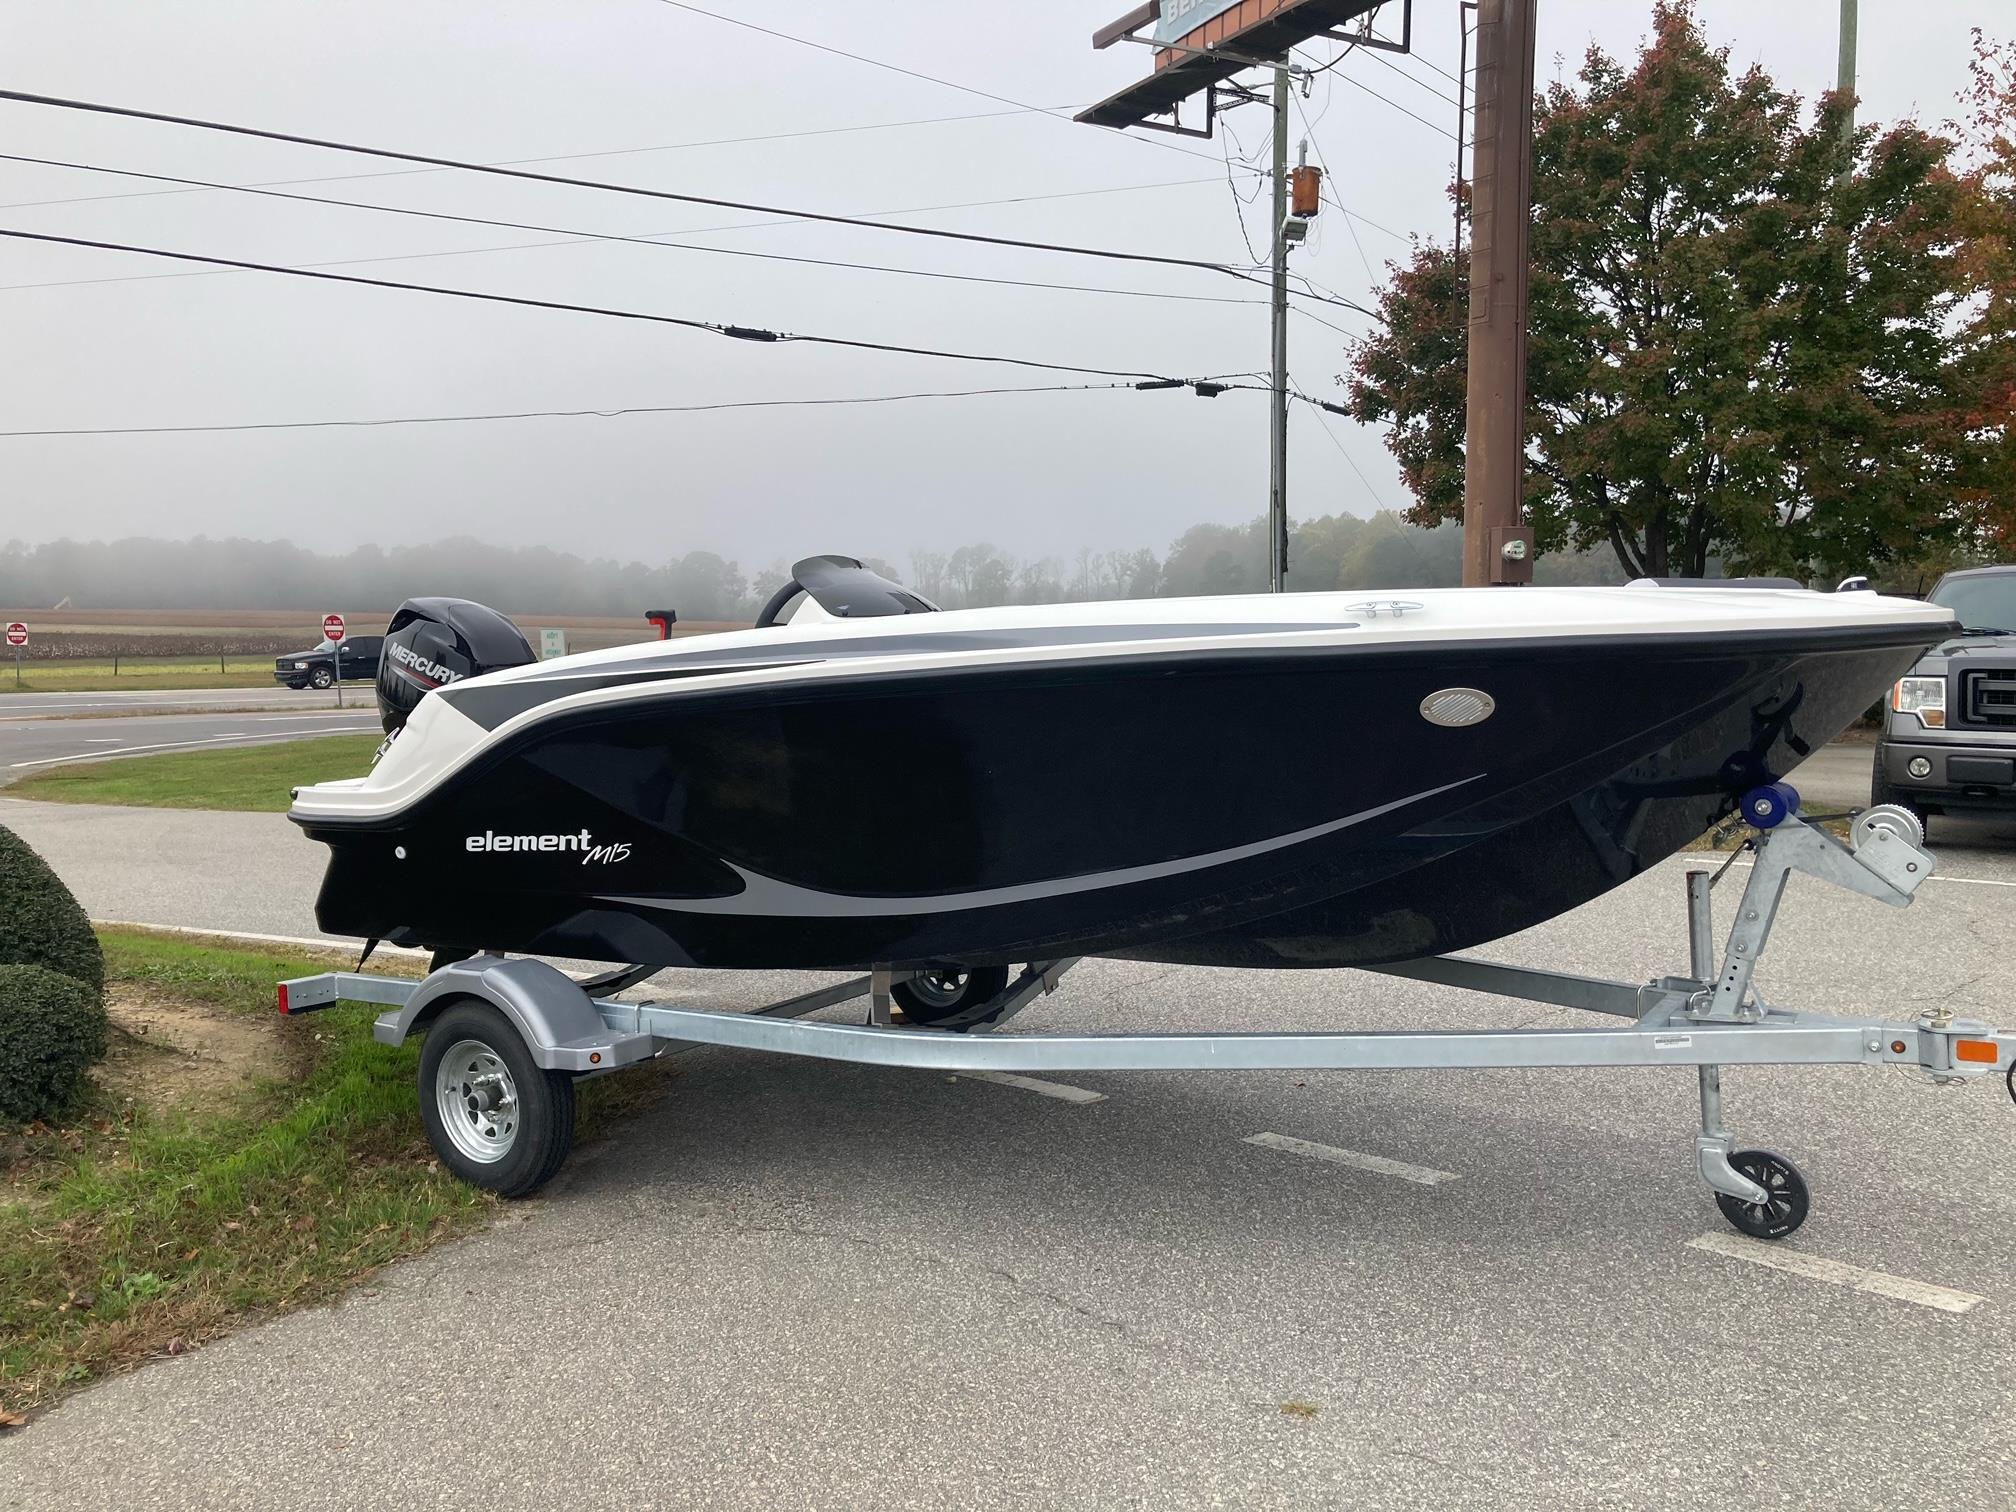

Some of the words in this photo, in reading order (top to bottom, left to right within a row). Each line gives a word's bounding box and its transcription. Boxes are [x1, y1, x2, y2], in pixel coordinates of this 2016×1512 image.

[389, 641, 464, 684] MERCURY
[466, 829, 592, 852] element
[583, 843, 632, 865] M15
